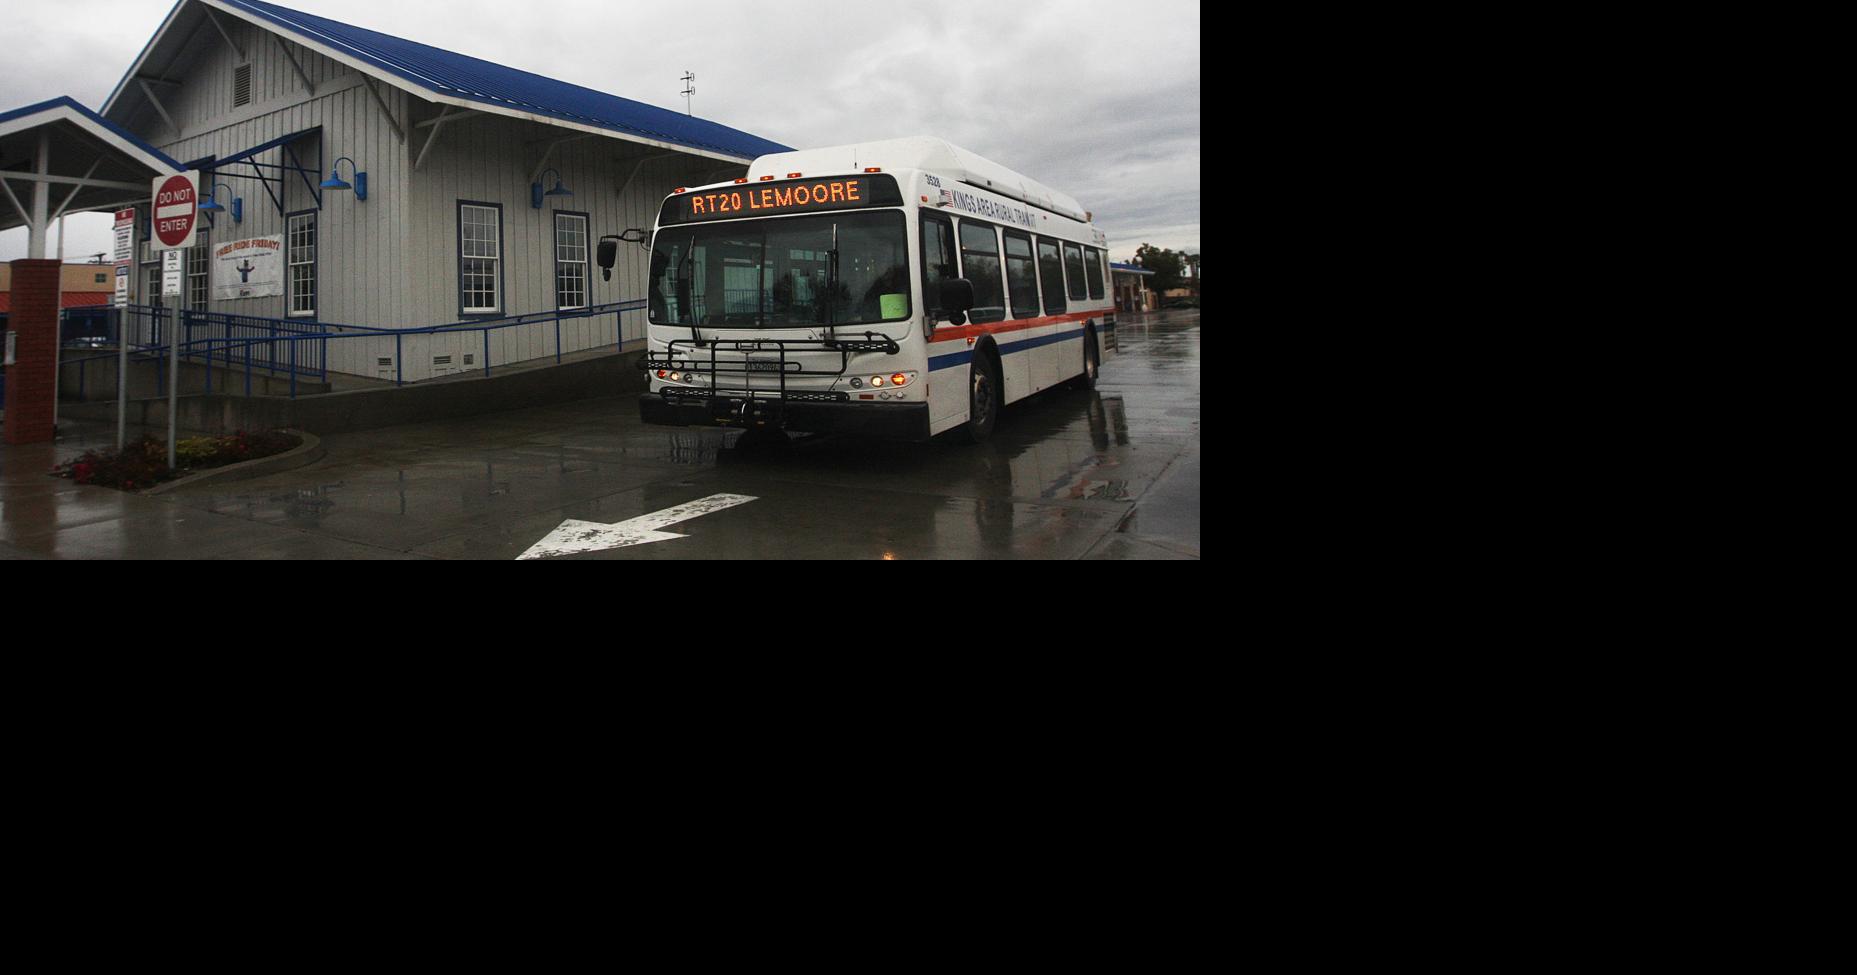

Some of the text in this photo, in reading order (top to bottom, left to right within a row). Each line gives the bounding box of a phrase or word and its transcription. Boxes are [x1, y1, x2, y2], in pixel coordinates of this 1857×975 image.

[160, 188, 191, 204] DO NOT
[692, 180, 860, 214] RT20 LEMOORE
[952, 189, 977, 214] KINGS
[977, 197, 995, 217] AREA
[995, 202, 1016, 223] RURAL
[160, 218, 188, 233] ENTER
